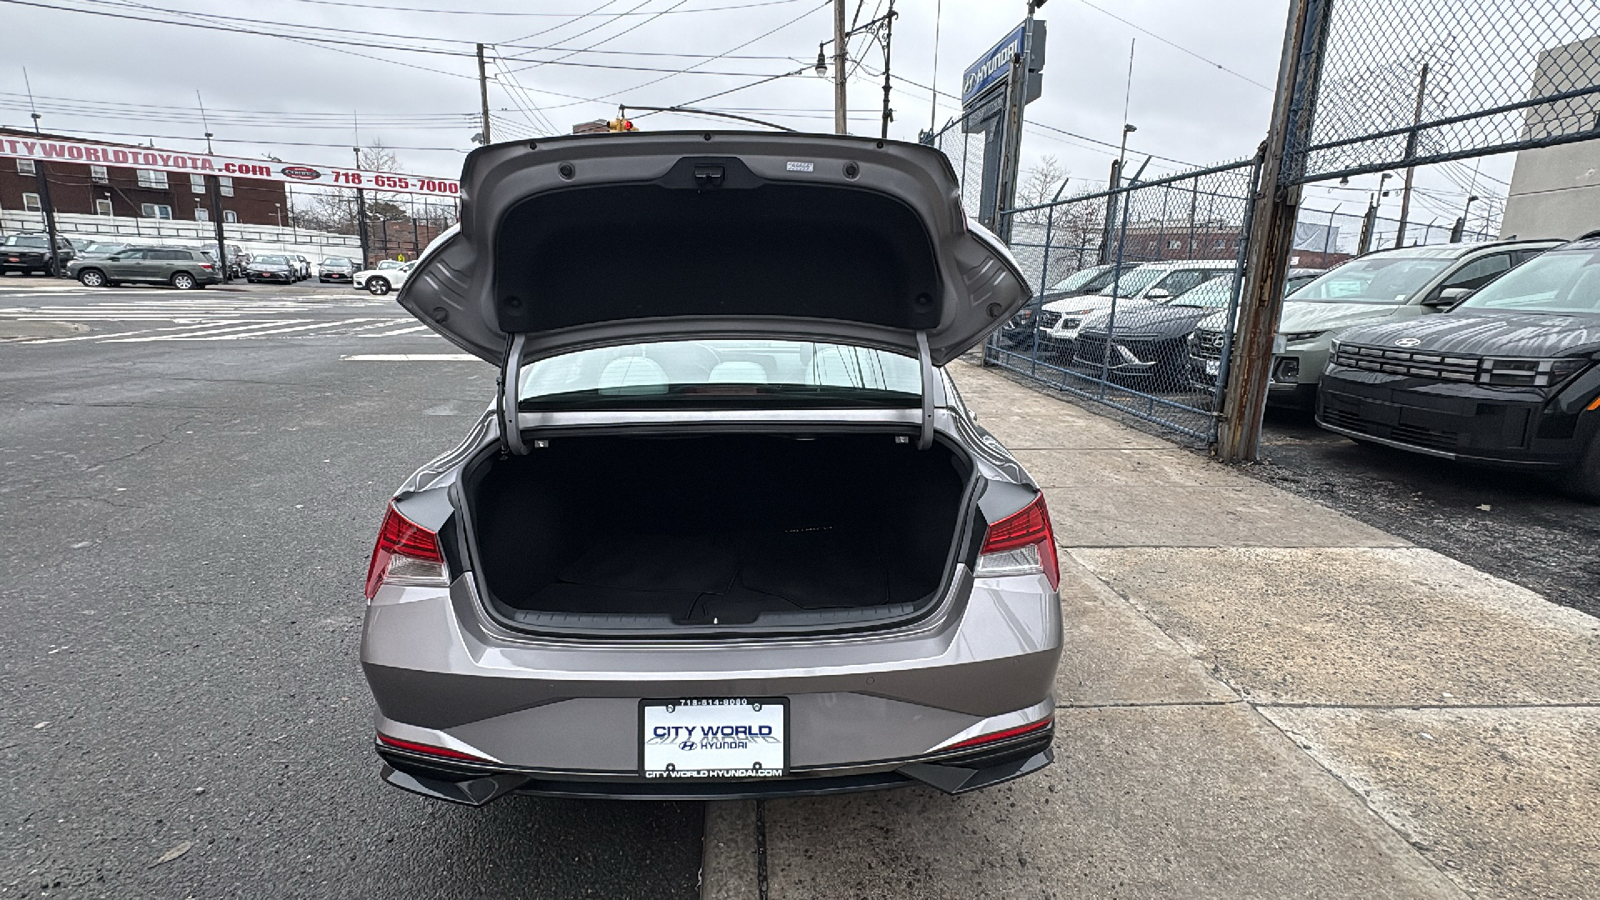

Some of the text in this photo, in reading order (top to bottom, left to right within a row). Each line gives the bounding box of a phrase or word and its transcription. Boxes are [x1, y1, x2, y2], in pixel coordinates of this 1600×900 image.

[976, 39, 1018, 83] HYUNDAI
[653, 725, 773, 737] CITY WORLD
[700, 741, 748, 750] HYUNDAI
[669, 770, 708, 778] WORLD
[709, 769, 783, 778] HYUNDAI.COM
